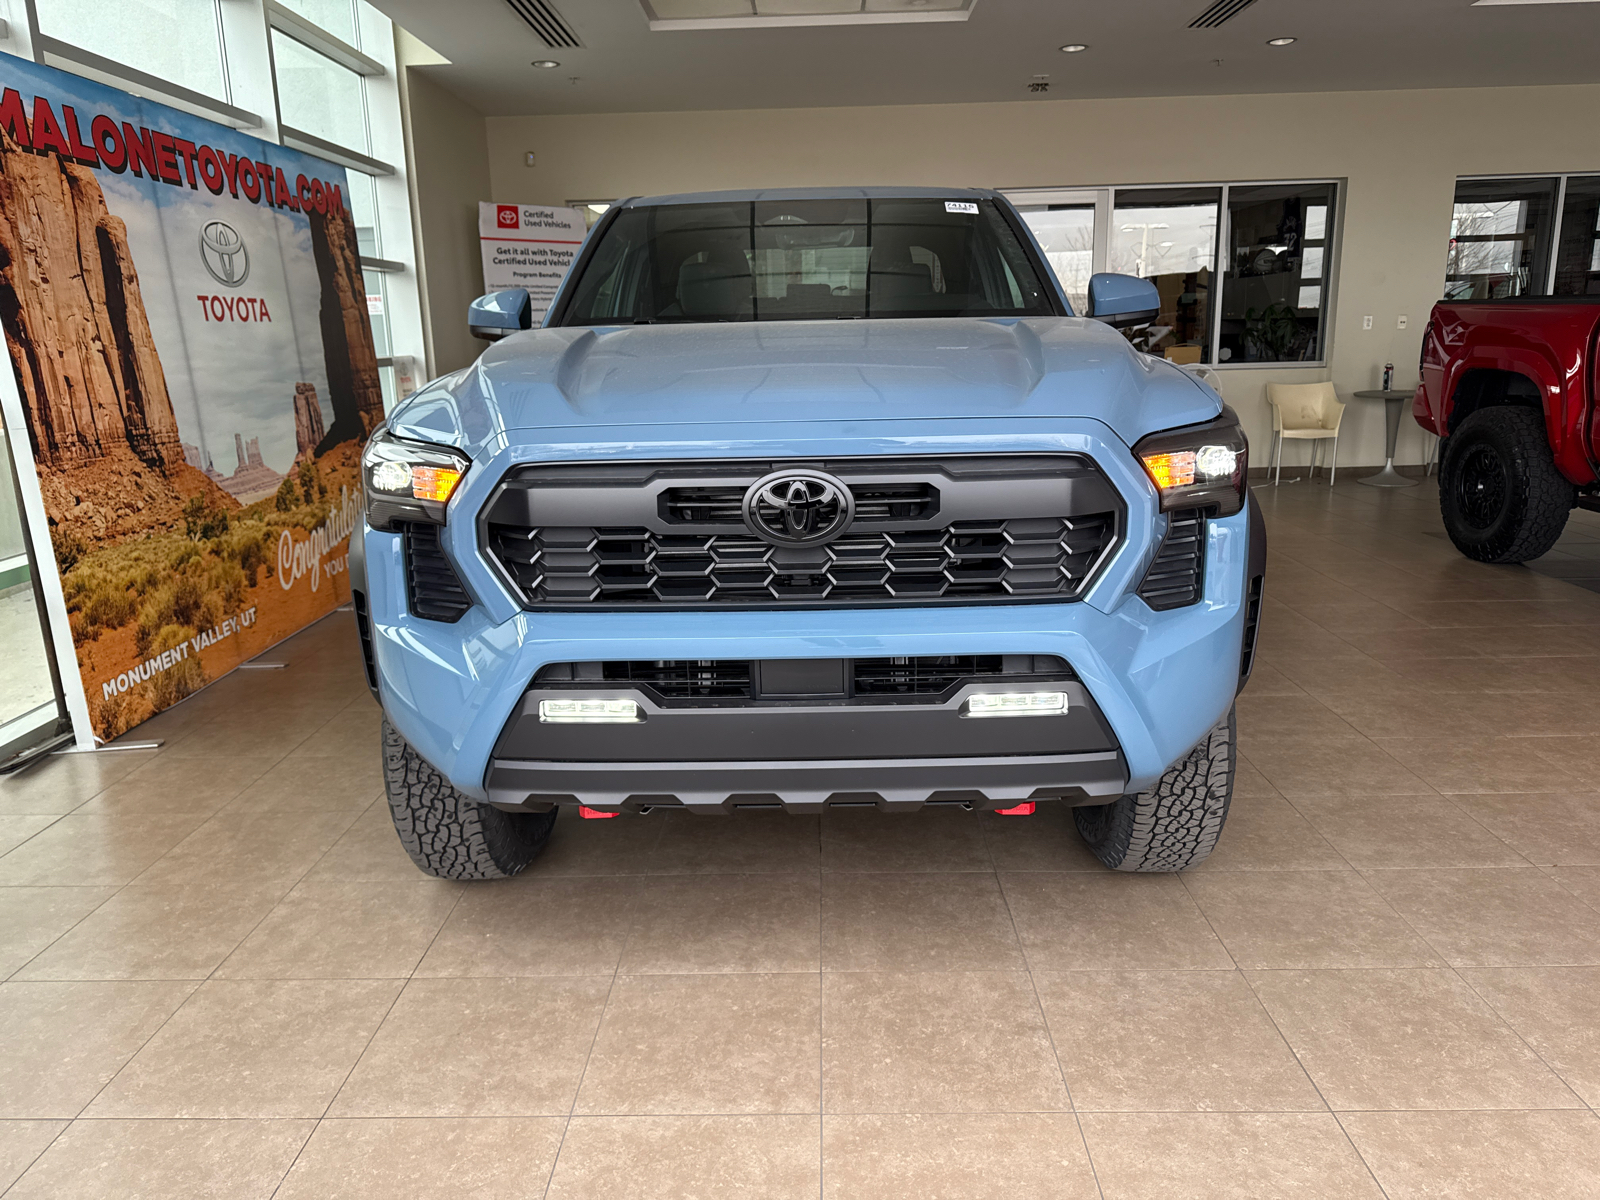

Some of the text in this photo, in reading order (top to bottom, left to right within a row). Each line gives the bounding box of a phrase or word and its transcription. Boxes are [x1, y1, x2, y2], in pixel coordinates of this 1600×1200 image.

[0, 87, 345, 218] MALONETOYOTA.COM
[523, 210, 554, 219] Certified
[524, 219, 571, 229] Used Vehicles
[496, 247, 511, 255] Get
[512, 247, 518, 255] it
[531, 248, 548, 256] with
[549, 249, 573, 258] Toyota
[493, 257, 527, 265] Certified
[197, 295, 272, 323] TOYOTA
[324, 556, 344, 578] YOU
[102, 606, 257, 701] MONUMENT VALLEY, UT
